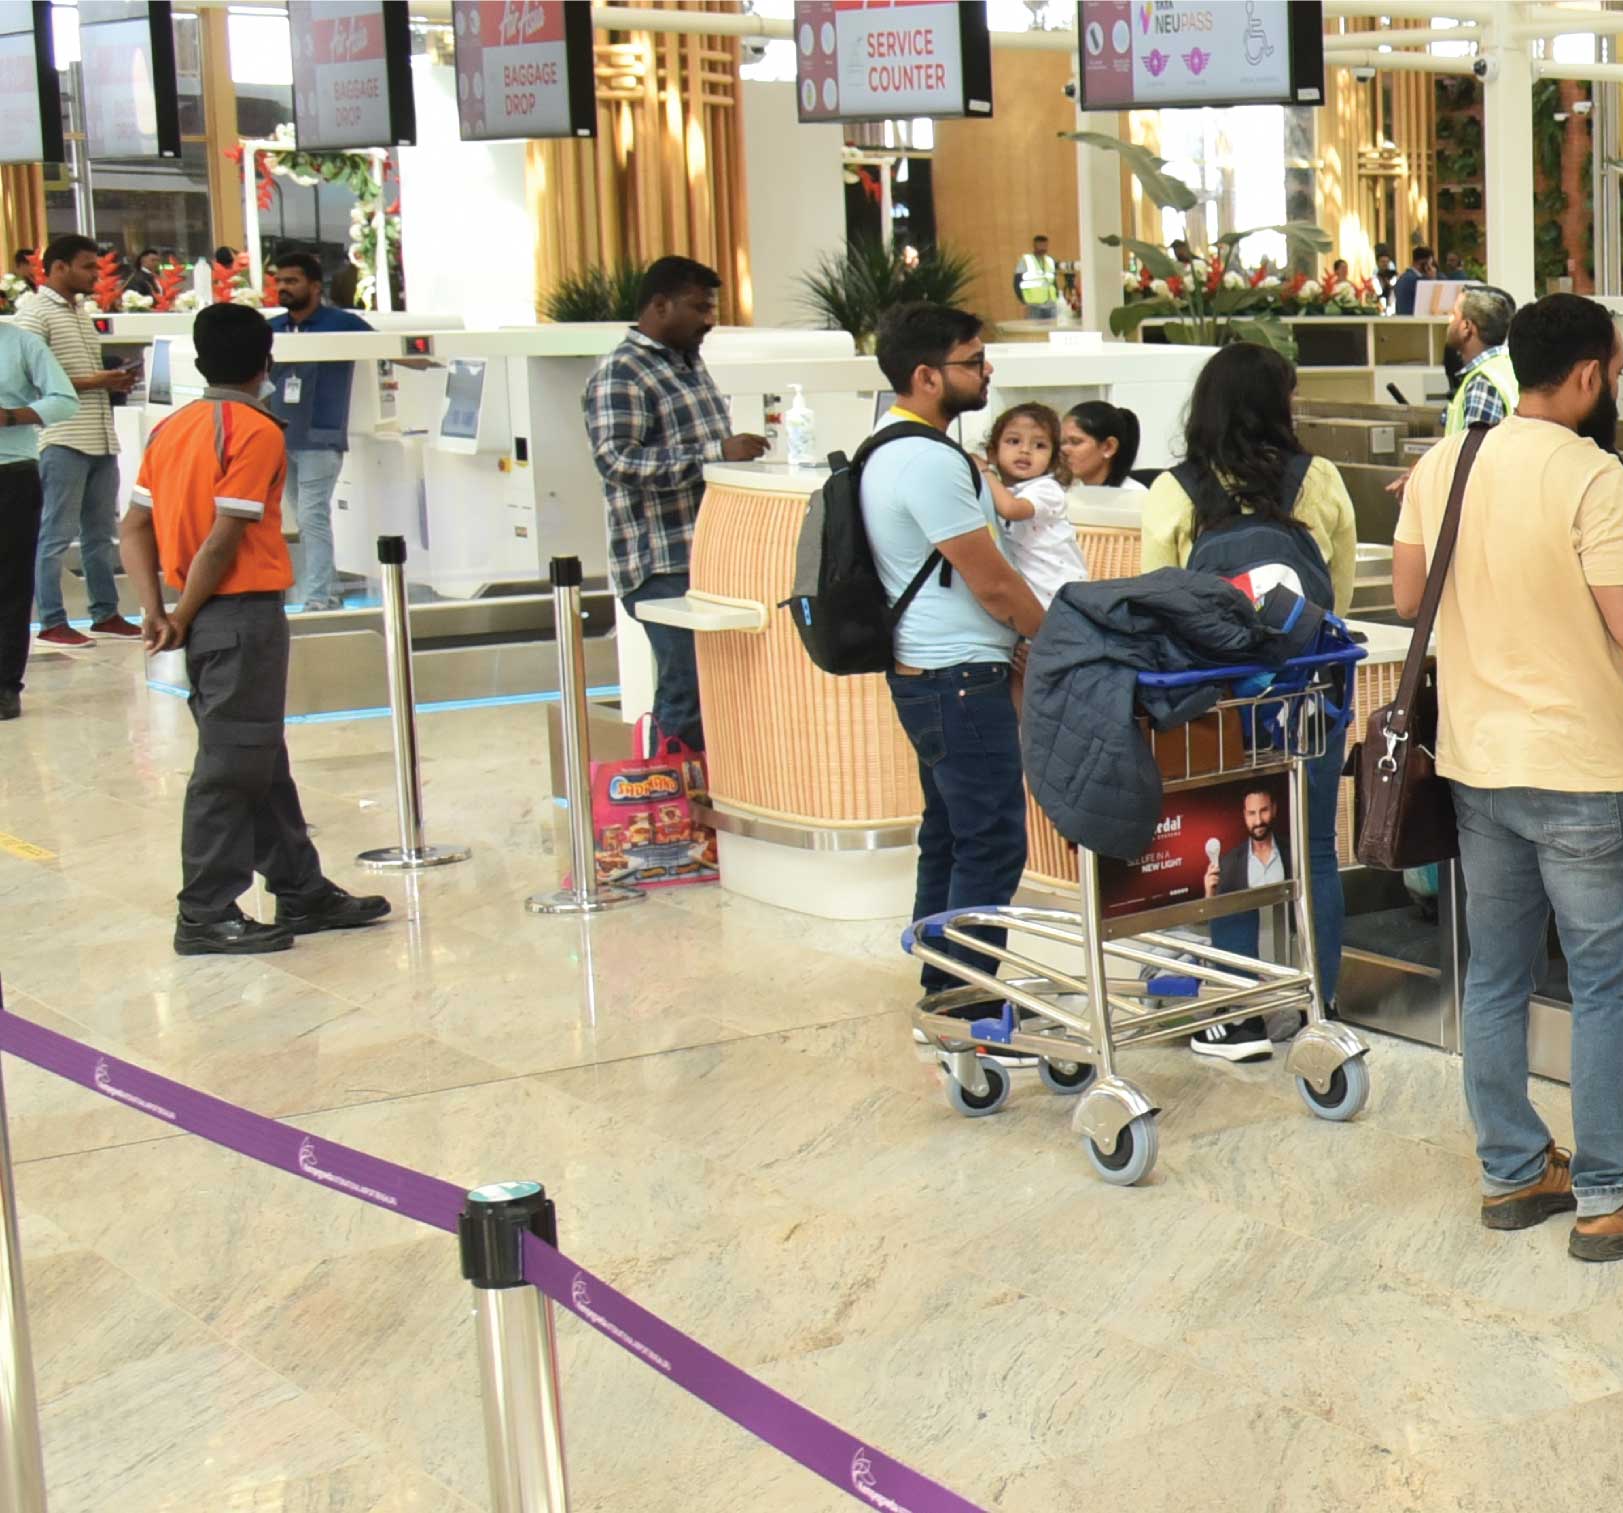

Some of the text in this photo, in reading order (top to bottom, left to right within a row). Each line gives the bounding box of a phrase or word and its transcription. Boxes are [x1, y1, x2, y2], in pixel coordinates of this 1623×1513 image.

[867, 29, 934, 58] SERVICE
[504, 62, 558, 87] BAGGAGE
[868, 64, 946, 92] COUNTER
[334, 78, 380, 101] BAGGAGE
[505, 94, 536, 116] DROP
[336, 107, 361, 127] DROP
[1154, 815, 1181, 834] edal
[1141, 862, 1160, 873] NEW
[1160, 857, 1182, 870] LIGHT
